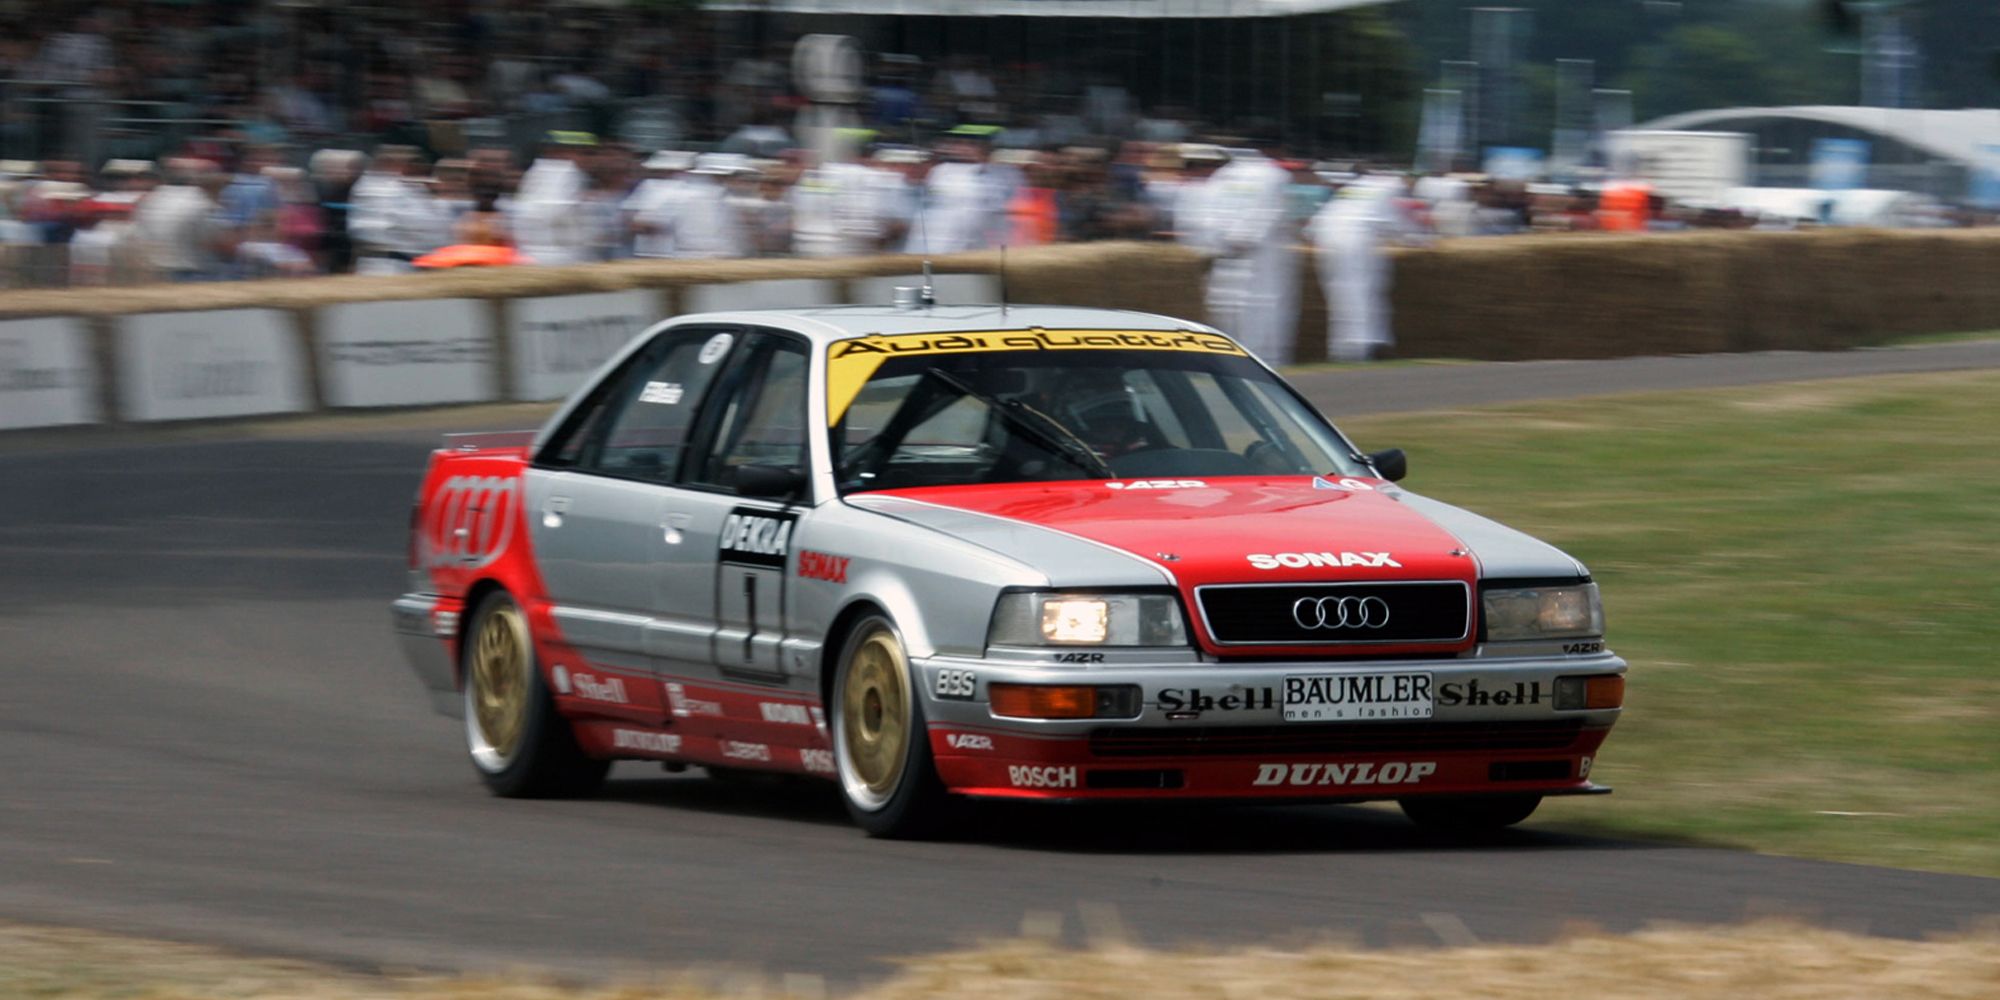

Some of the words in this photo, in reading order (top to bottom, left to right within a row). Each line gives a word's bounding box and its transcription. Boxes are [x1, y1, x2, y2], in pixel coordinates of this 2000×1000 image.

[832, 336, 988, 358] Audi
[1003, 332, 1235, 350] quattro
[1122, 479, 1208, 490] AZR
[720, 514, 792, 555] DEKRA
[798, 551, 850, 584] SONAX
[1247, 552, 1402, 570] SONAX
[743, 573, 757, 662] 1
[1060, 652, 1104, 664] AZR
[1568, 642, 1601, 655] AZR
[936, 669, 976, 696] BBS
[1284, 674, 1432, 705] BÄUMLER
[1436, 680, 1542, 707] Shell
[1156, 687, 1274, 713] Shell
[1284, 707, 1343, 719] men's
[1358, 705, 1432, 717] fashion
[956, 735, 995, 750] AZR
[1008, 765, 1077, 788] BOSCH
[1252, 762, 1436, 787] DUNLOP
